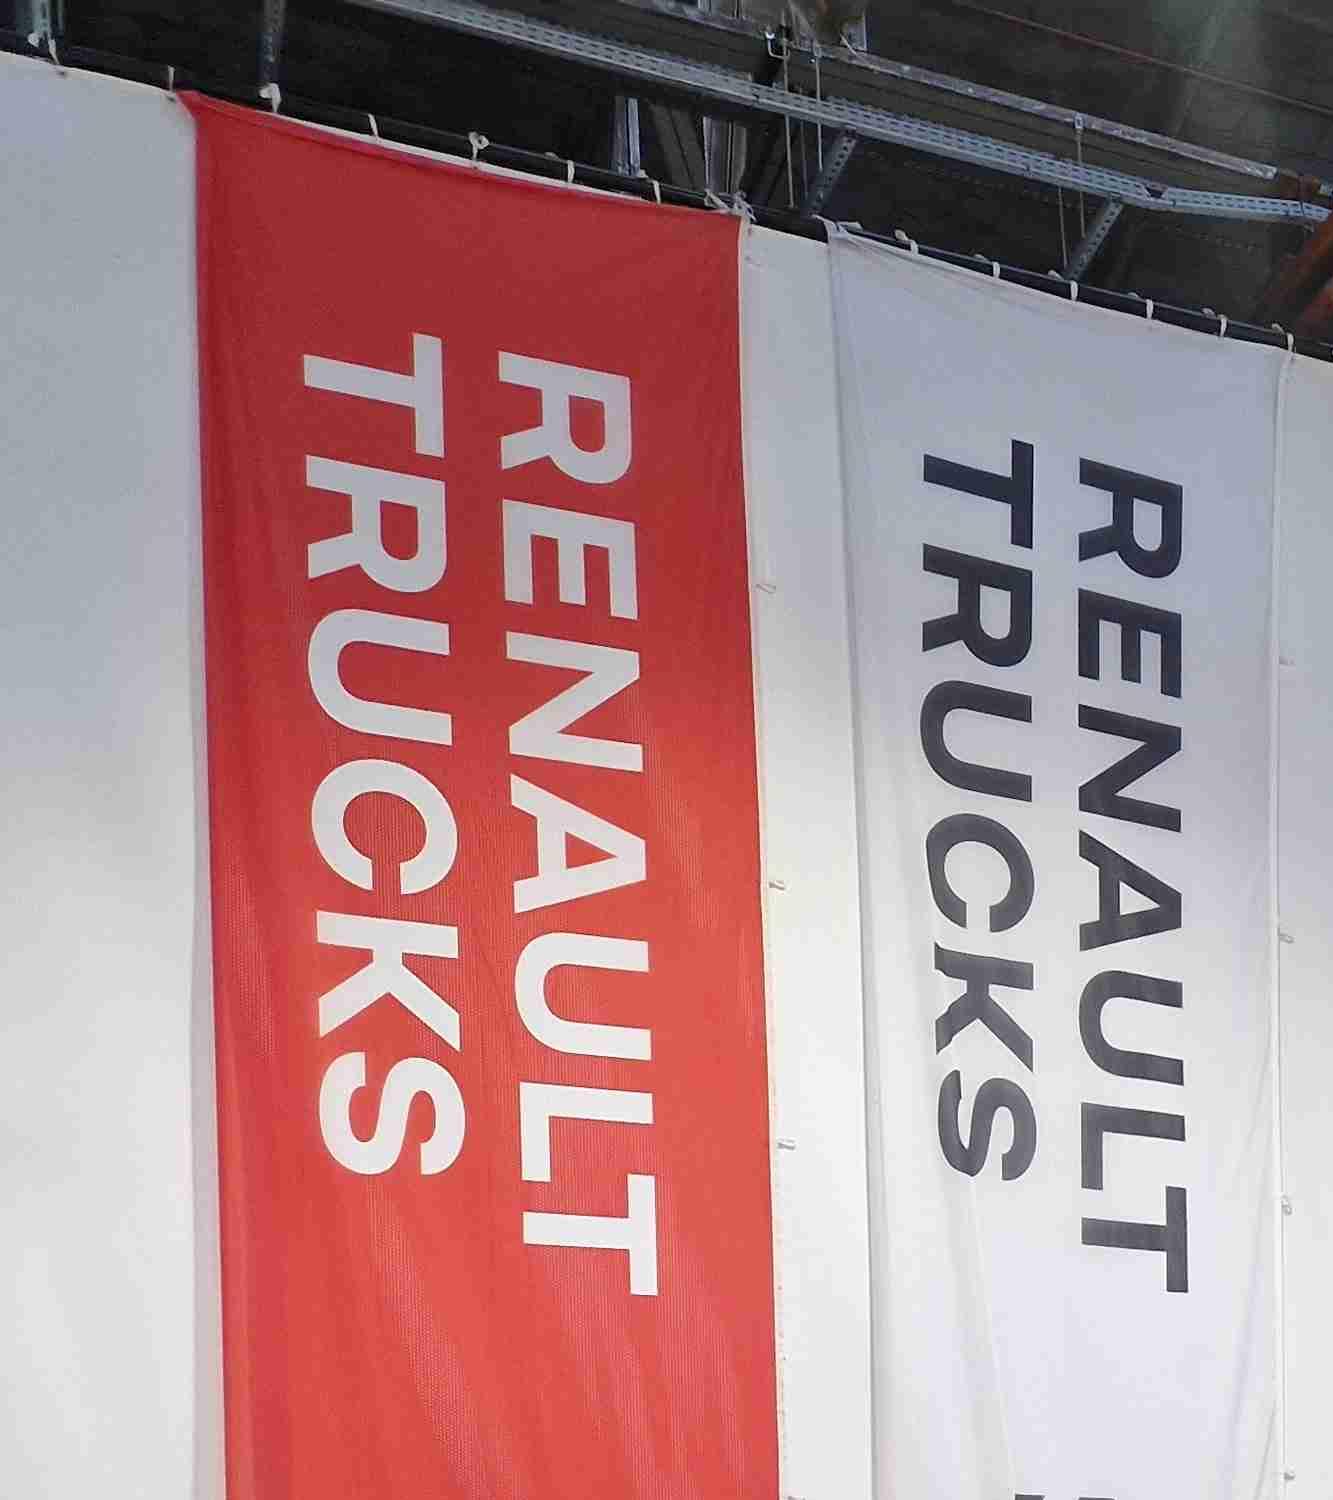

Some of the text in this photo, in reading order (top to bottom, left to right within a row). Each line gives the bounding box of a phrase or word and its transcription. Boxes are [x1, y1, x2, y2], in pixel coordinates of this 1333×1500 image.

[303, 333, 466, 1176] TRUCKS
[498, 350, 658, 1296] RENAULT
[919, 438, 1037, 1182] TRUCKS
[1078, 456, 1188, 1293] RENAULT
